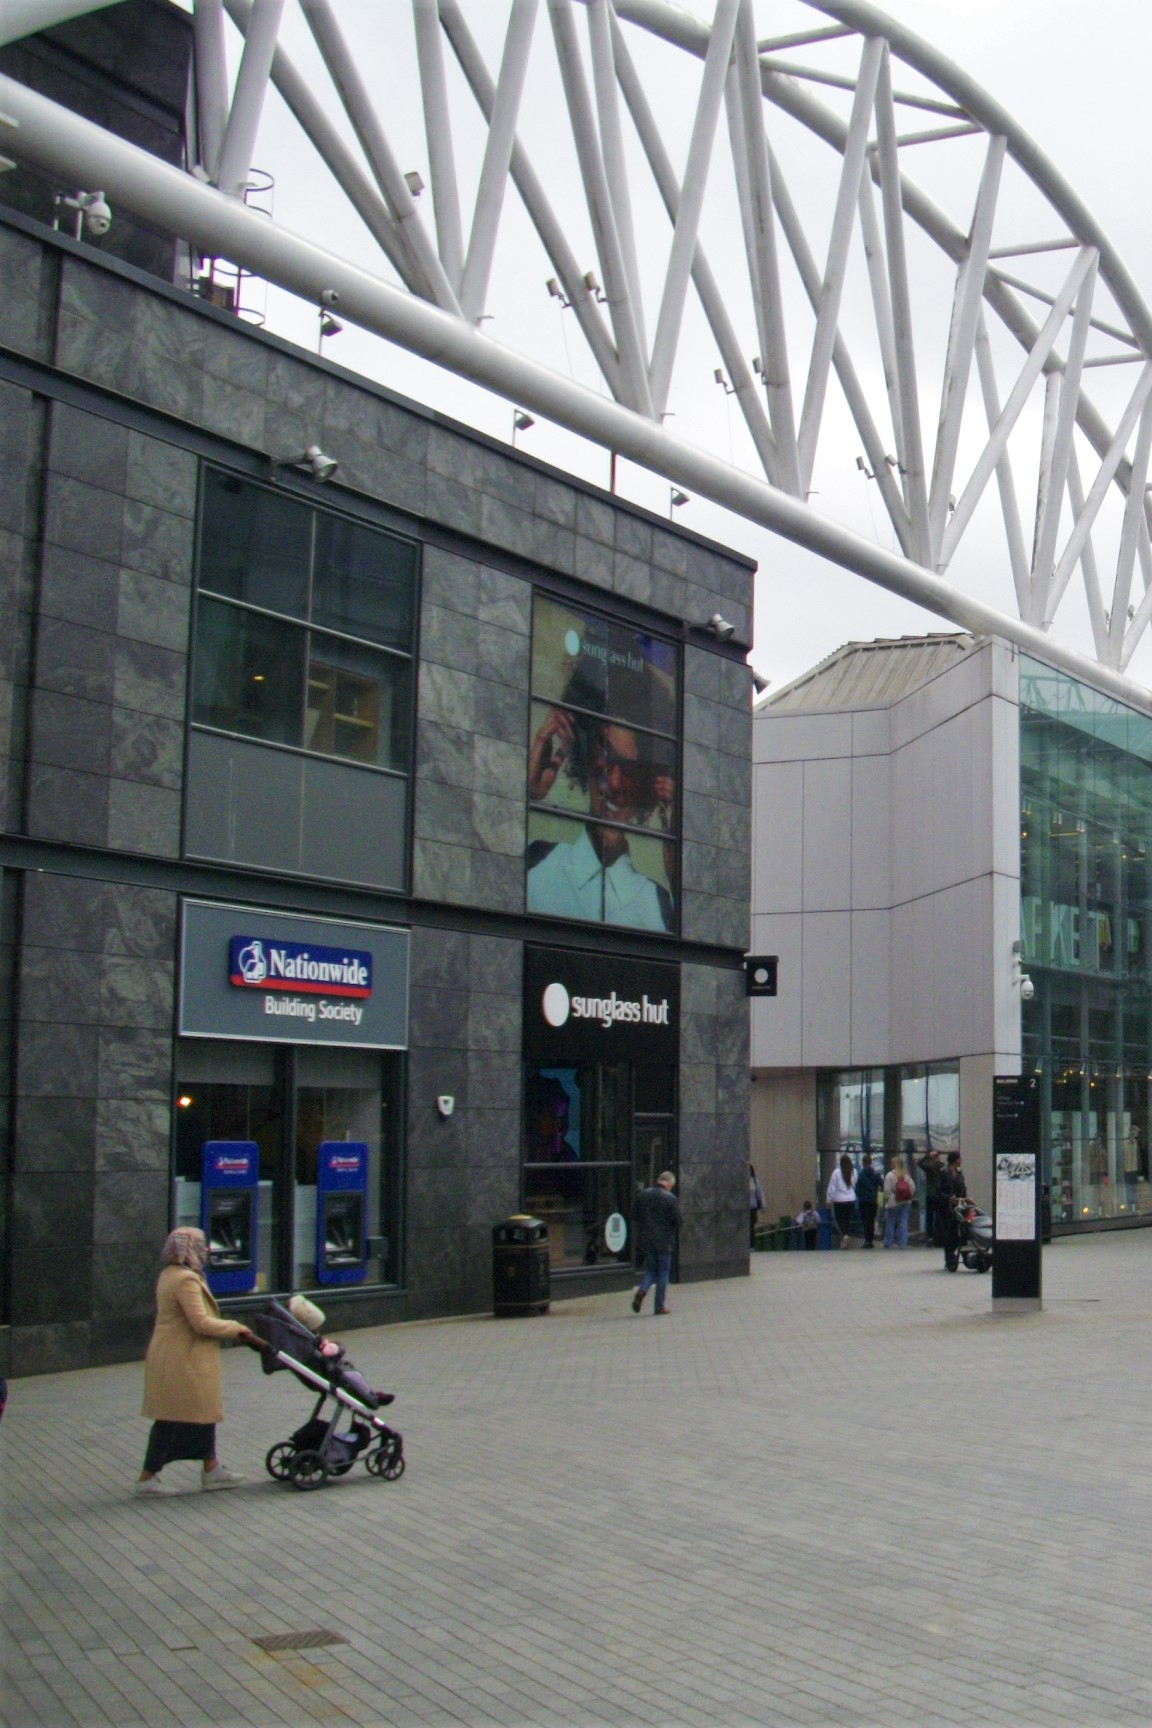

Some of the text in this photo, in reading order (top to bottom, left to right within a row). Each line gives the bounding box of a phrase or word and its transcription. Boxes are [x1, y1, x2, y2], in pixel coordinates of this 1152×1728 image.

[582, 641, 643, 673] sungass hut
[270, 949, 369, 985] Nationwide
[265, 996, 363, 1025] Building Society
[571, 991, 669, 1028] sunglass hut
[1030, 1078, 1036, 1088] 2
